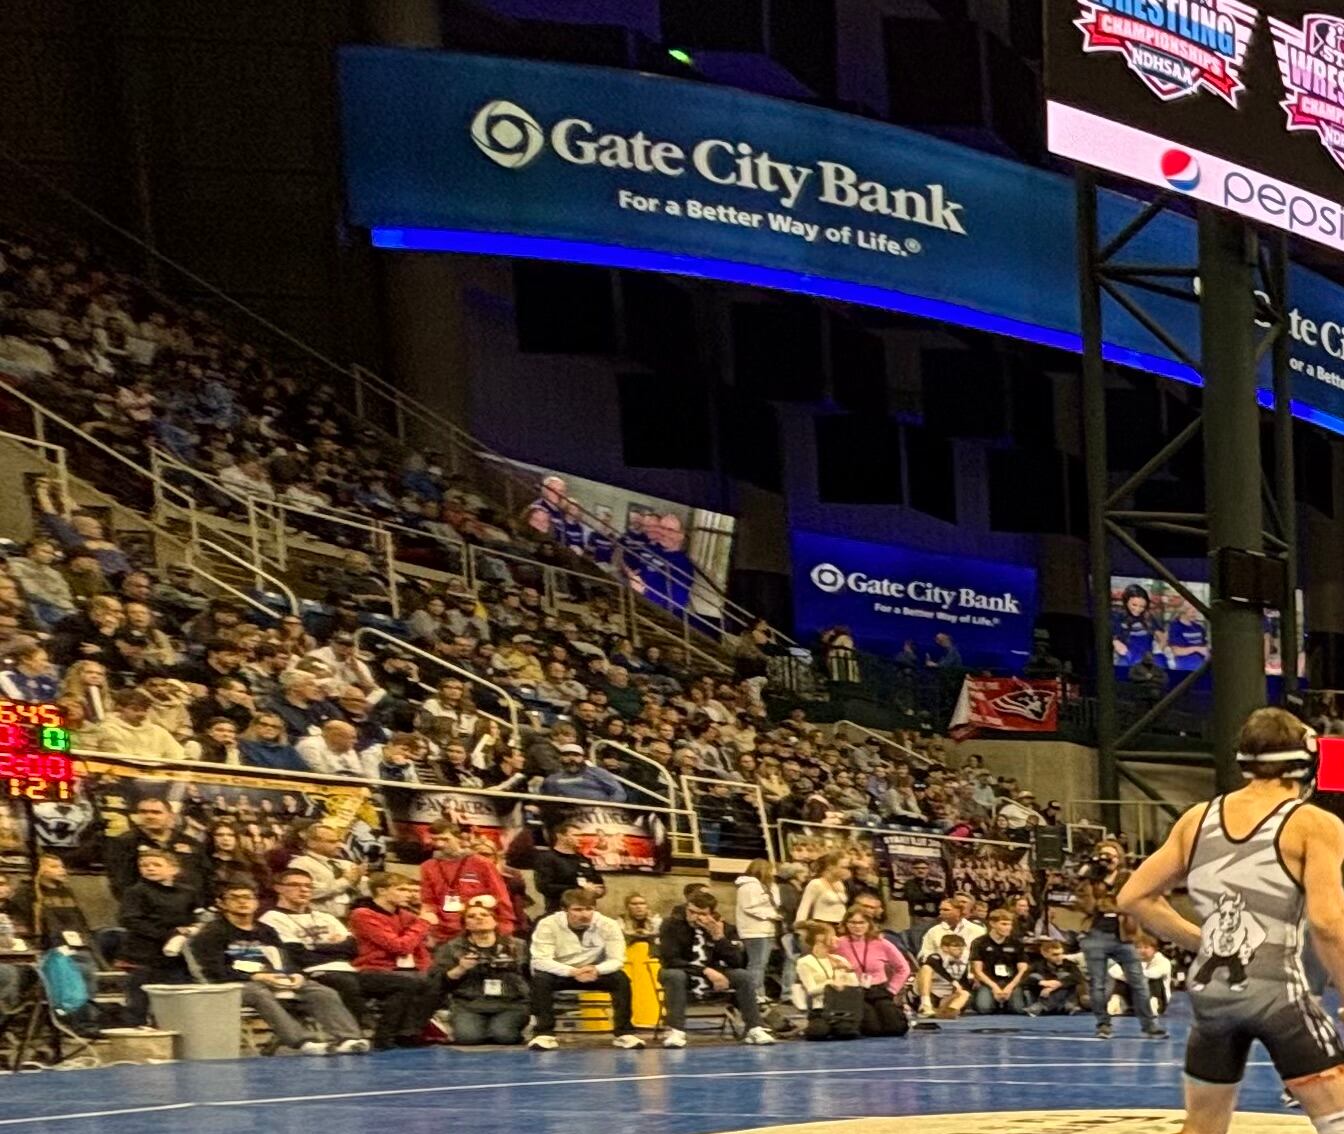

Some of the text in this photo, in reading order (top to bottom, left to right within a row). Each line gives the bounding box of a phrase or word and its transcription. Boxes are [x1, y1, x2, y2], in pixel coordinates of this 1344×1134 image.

[1101, 13, 1222, 77] CHAMPIONSHIPS
[1131, 49, 1194, 85] NDHSAA
[551, 117, 968, 235] Gate City Bank
[619, 189, 660, 214] For
[665, 199, 680, 216] a
[686, 199, 762, 229] Better
[768, 212, 819, 243] Way
[825, 221, 852, 245] of
[1289, 308, 1318, 346] te
[1289, 357, 1304, 372] or
[1307, 364, 1315, 377] a
[847, 572, 1021, 615] Gate City Bank
[874, 602, 893, 614] For
[894, 606, 901, 615] a
[936, 611, 958, 624] Way
[959, 614, 971, 624] of
